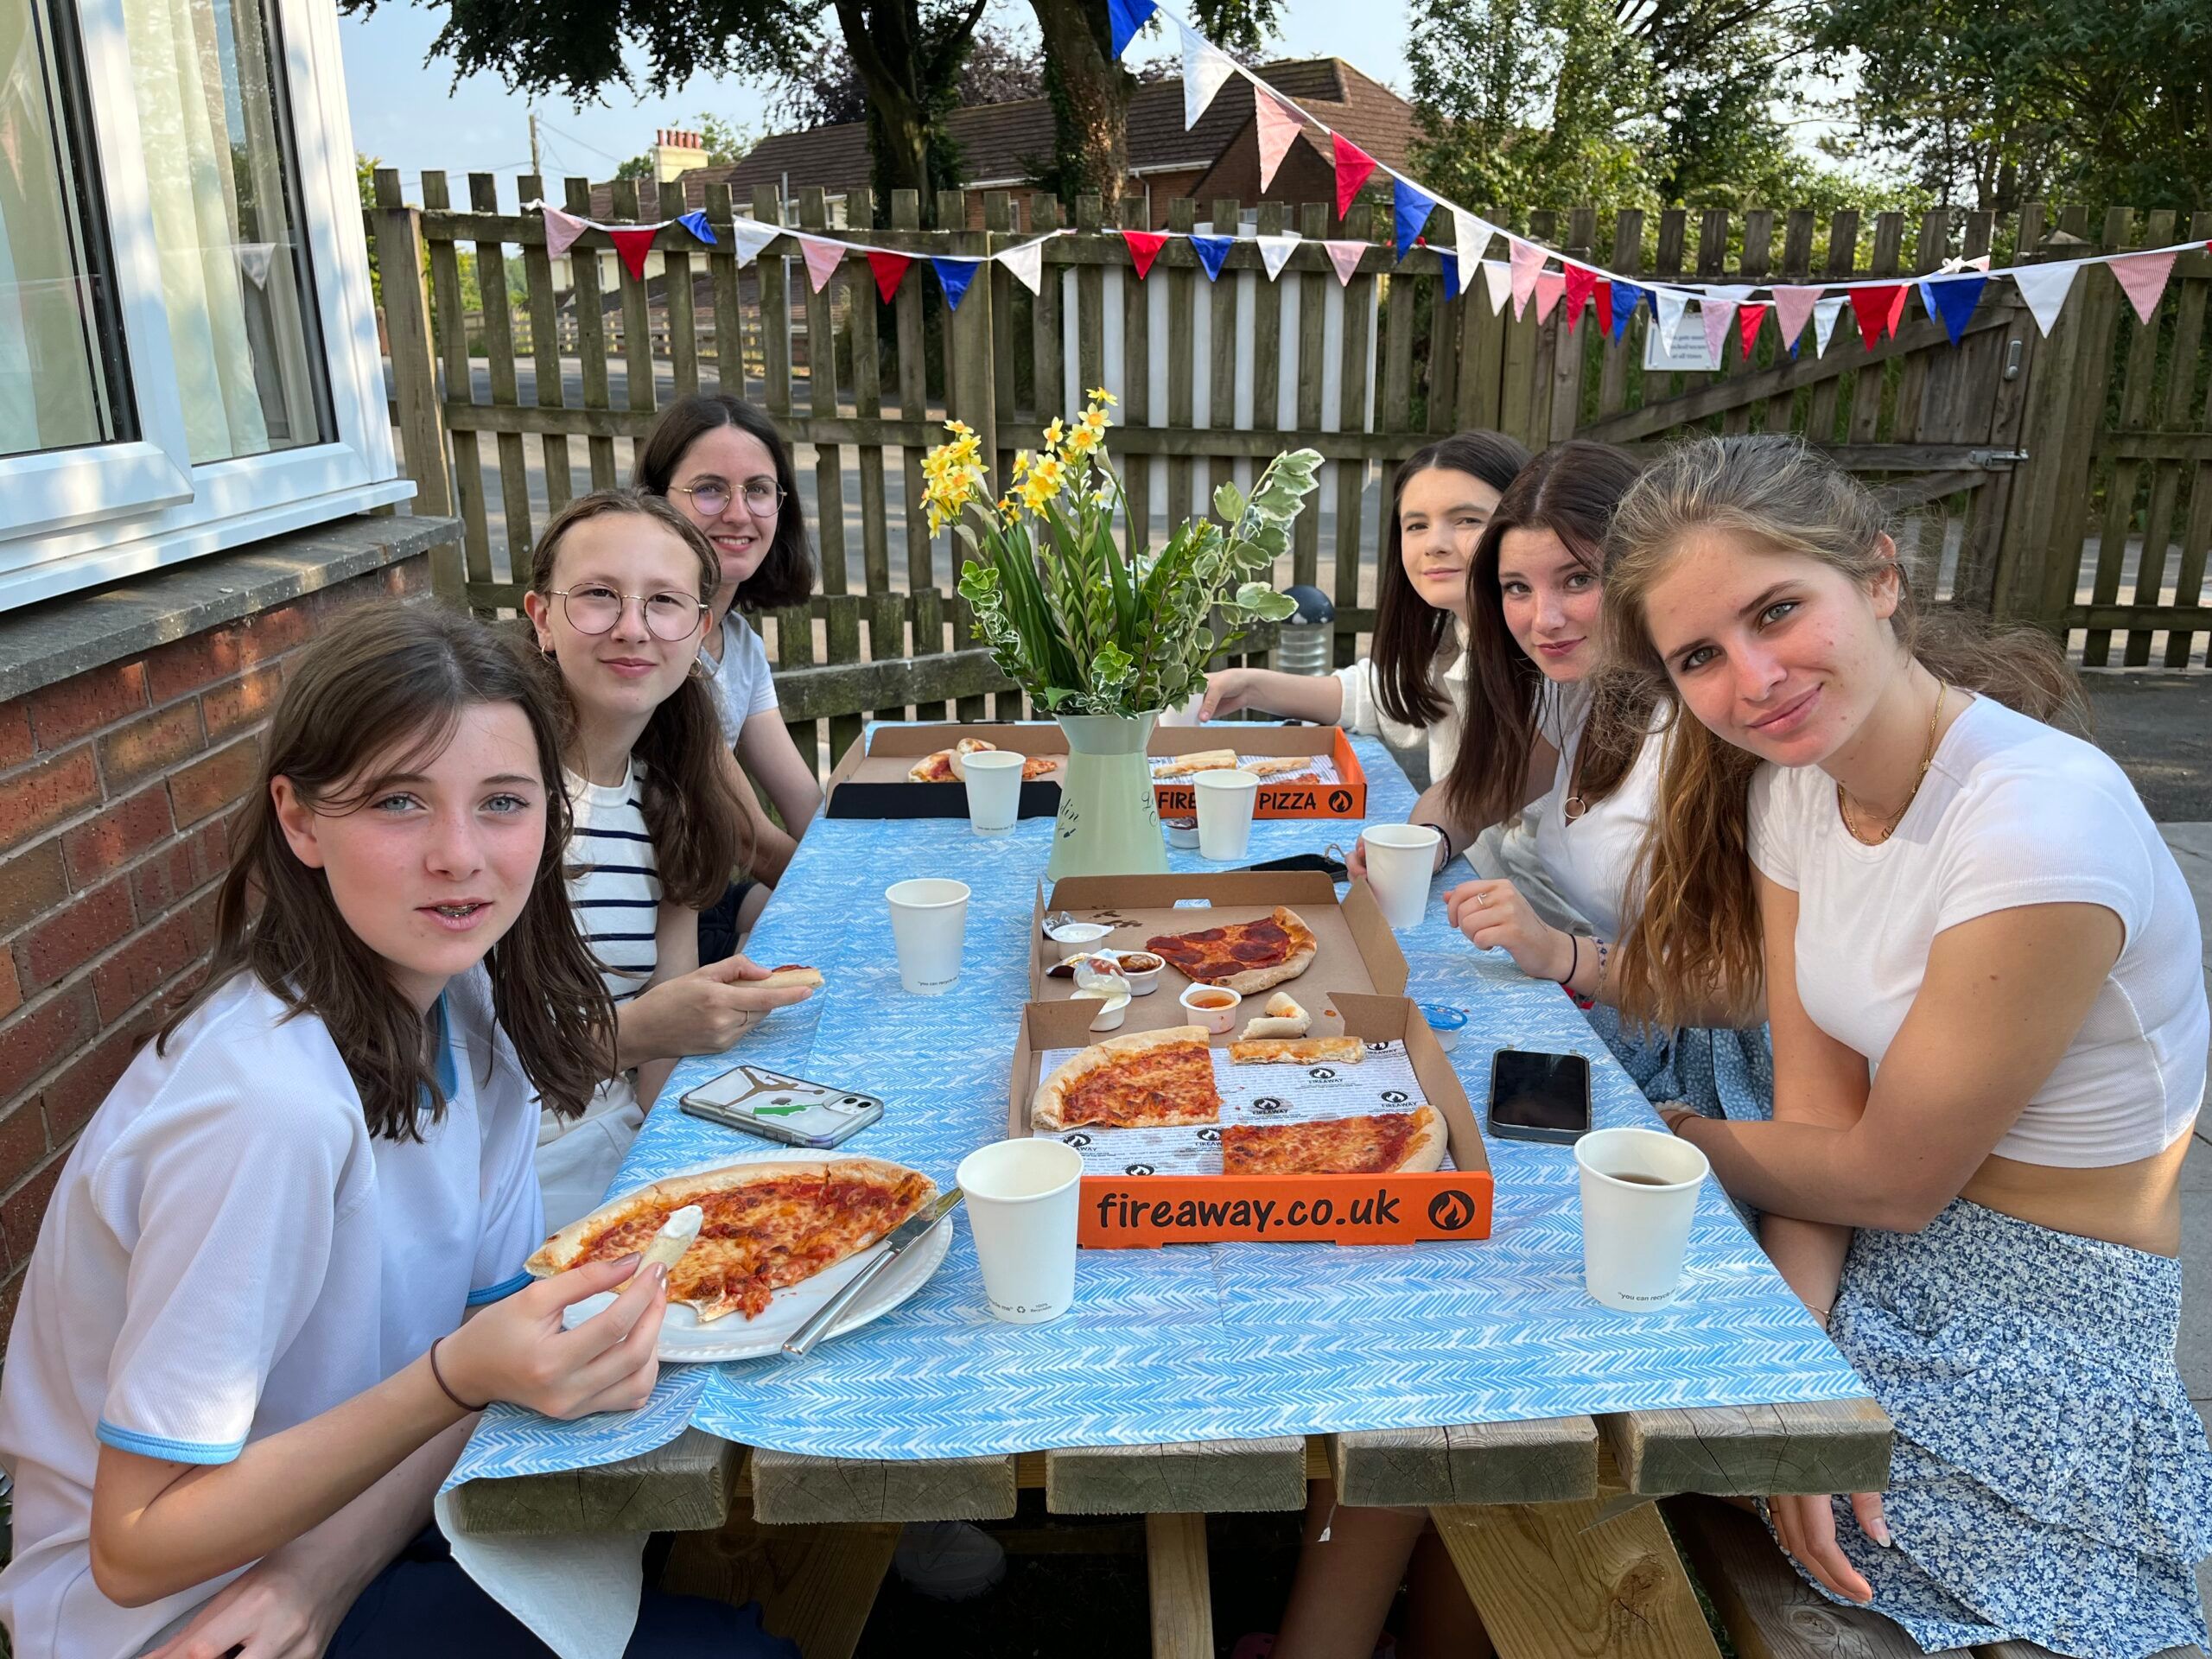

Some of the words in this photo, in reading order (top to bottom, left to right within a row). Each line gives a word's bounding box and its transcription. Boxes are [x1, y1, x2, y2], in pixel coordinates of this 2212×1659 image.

[1158, 791, 1197, 810] FIRE
[1259, 792, 1317, 810] PIZZA
[1096, 1189, 1401, 1233] fireaway.co.uk
